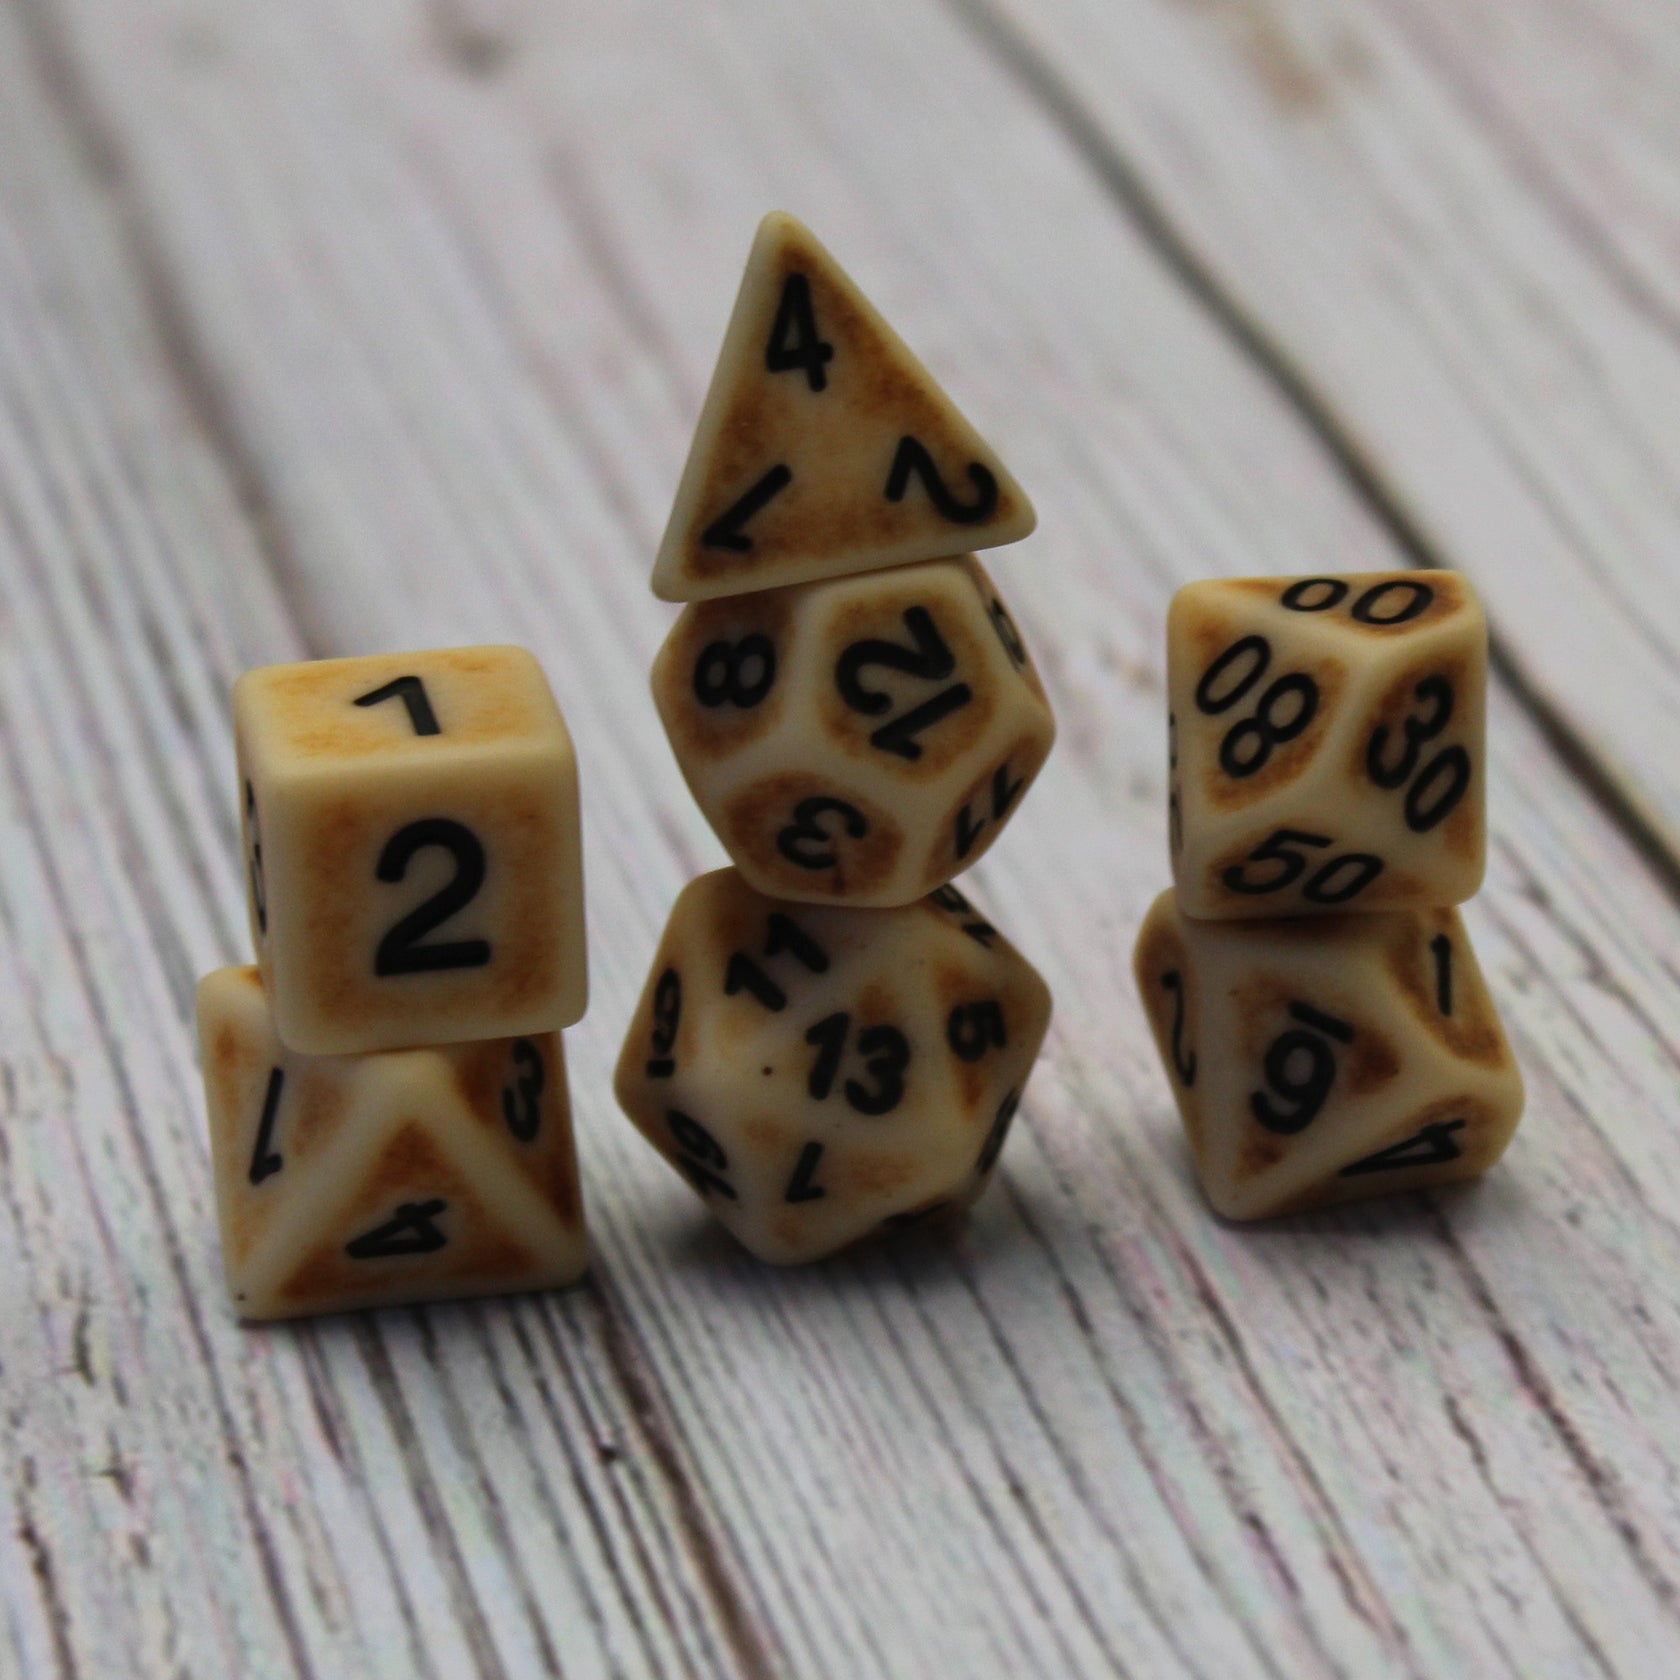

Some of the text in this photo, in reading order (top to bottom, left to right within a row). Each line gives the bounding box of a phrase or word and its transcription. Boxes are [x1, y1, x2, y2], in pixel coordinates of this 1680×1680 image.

[766, 273, 834, 392] 4
[884, 435, 998, 526] 2
[1280, 578, 1434, 625] 00
[352, 675, 442, 737] 1
[693, 633, 777, 708] 8
[834, 605, 974, 763] 12
[1365, 674, 1471, 833] 30
[777, 796, 871, 870] 3
[1222, 829, 1385, 904] 50
[374, 818, 492, 978] 2
[724, 913, 830, 1012] 11
[1431, 933, 1453, 1017] 1
[502, 1038, 544, 1143] 3
[805, 1011, 911, 1116] 13
[1338, 1119, 1467, 1178] 4
[345, 1198, 448, 1260] 4
